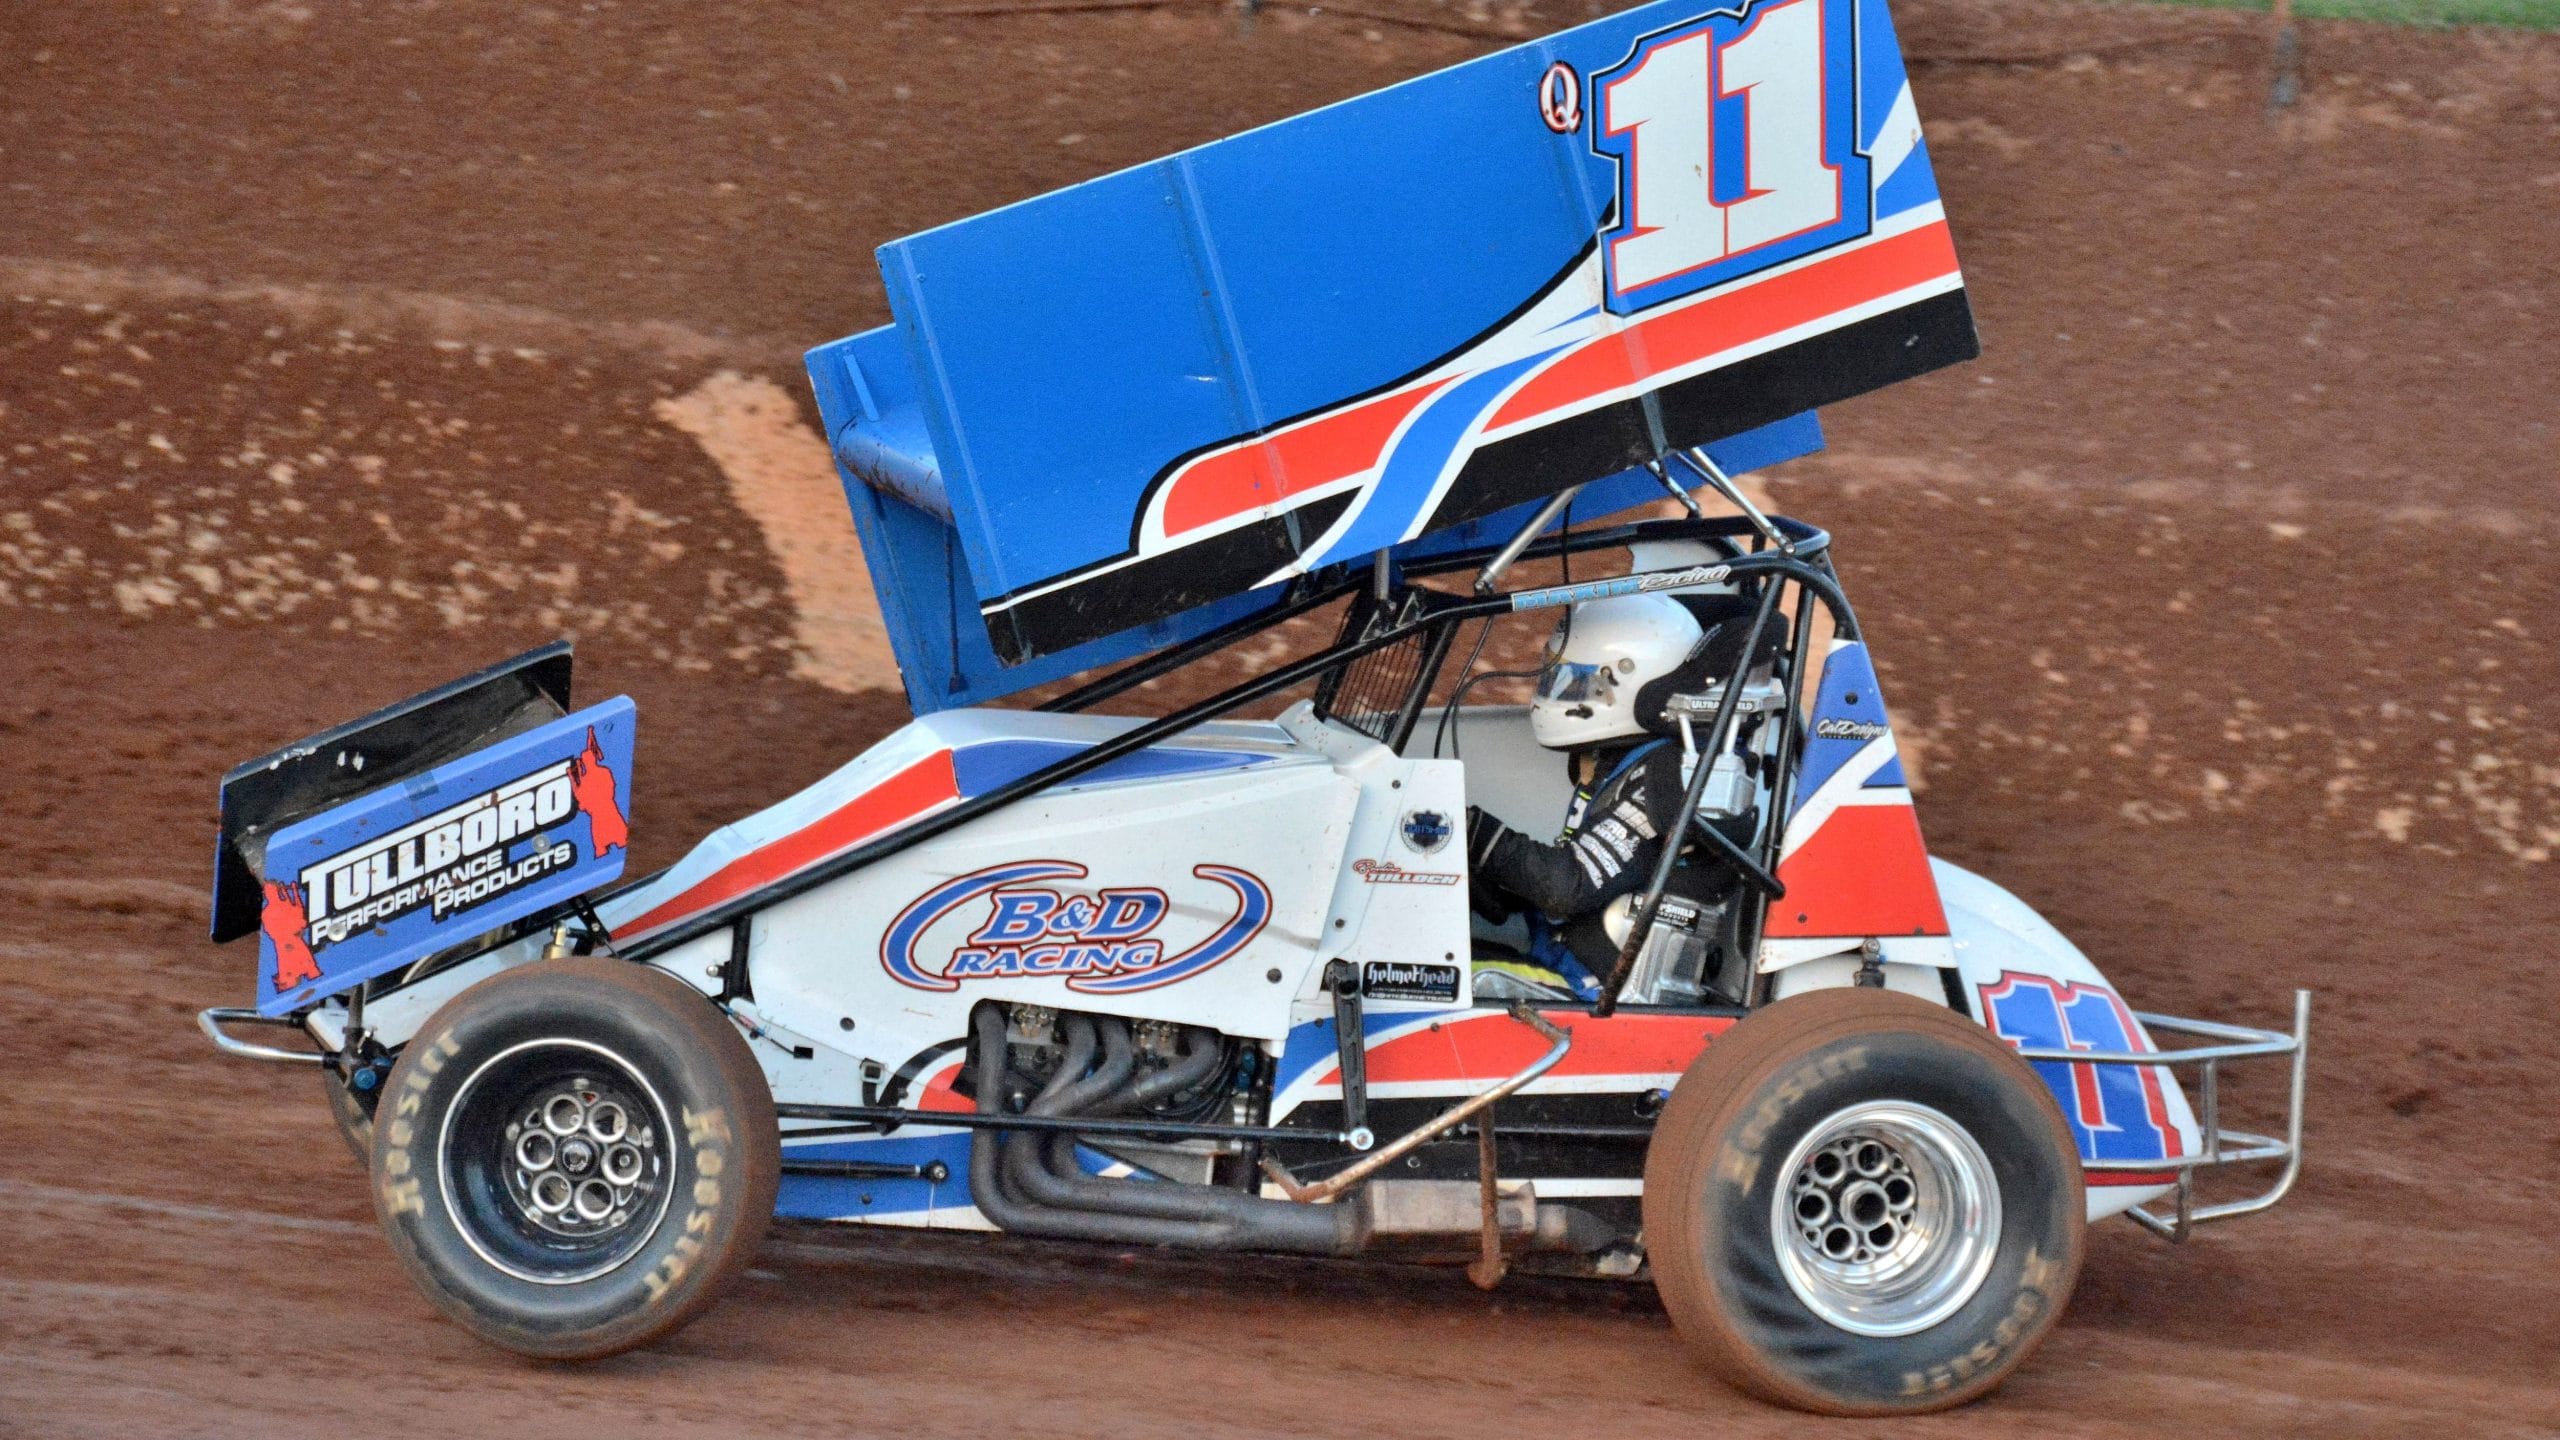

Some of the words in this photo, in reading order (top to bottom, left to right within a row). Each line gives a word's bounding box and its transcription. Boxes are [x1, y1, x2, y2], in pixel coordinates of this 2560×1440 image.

[1540, 60, 1582, 134] Q
[1605, 0, 1842, 294] 11
[1513, 577, 1644, 611] MAXIM
[301, 760, 573, 923] TULLBORO
[432, 842, 571, 917] PRODUCTS
[972, 889, 1168, 944] B&D
[947, 942, 1158, 976] RACING
[1980, 972, 2178, 1170] 11
